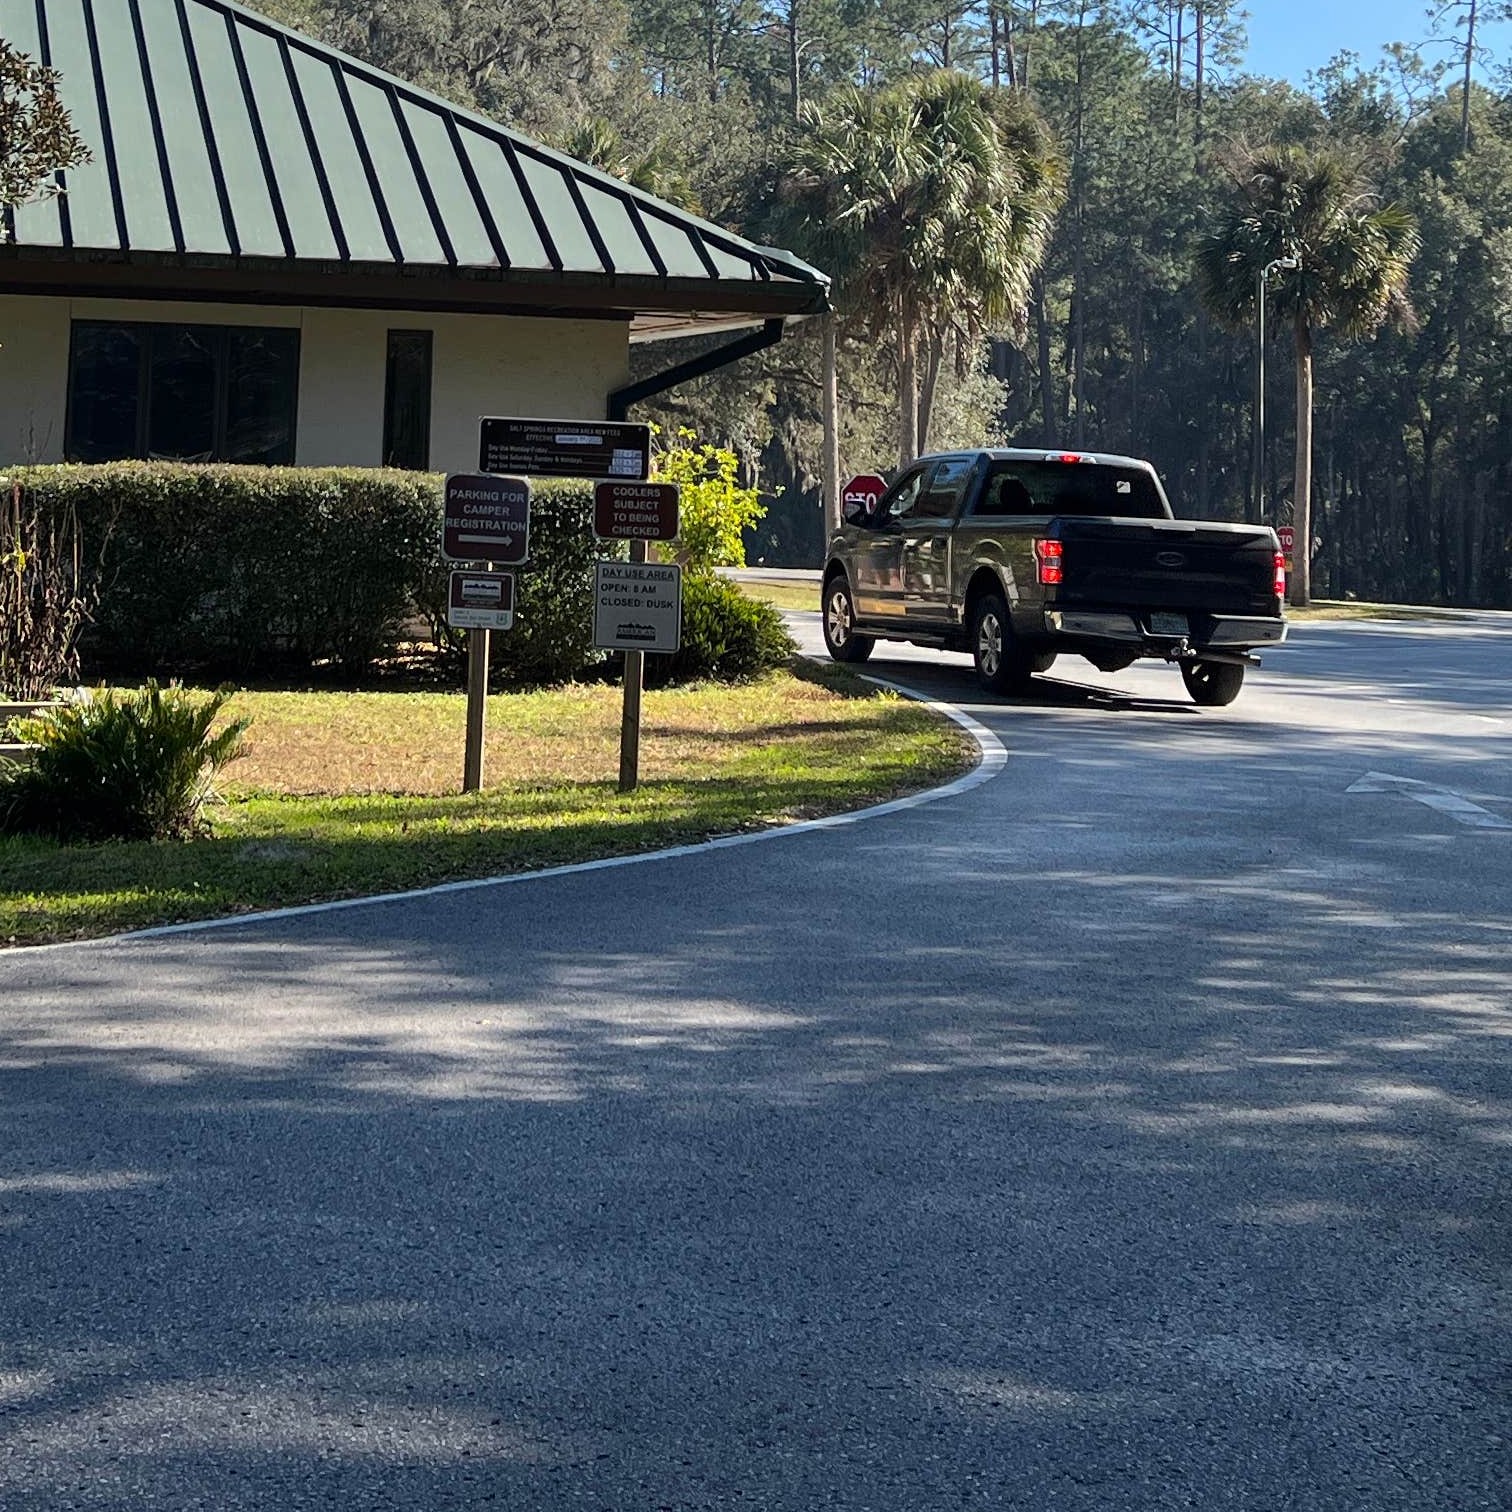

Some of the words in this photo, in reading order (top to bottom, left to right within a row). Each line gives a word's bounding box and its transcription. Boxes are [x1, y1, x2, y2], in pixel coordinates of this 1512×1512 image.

[450, 489, 499, 501] PARKING
[502, 492, 524, 503] FOR
[613, 488, 661, 497] COOLERS
[463, 504, 510, 516] CAMPER
[614, 499, 659, 510] SUBJECT
[614, 512, 627, 522] TO
[629, 513, 660, 523] BEING
[445, 517, 527, 532] REGISTRATION
[612, 525, 660, 536] CHECKED
[602, 568, 622, 578] DAY
[625, 569, 645, 580] USE
[648, 570, 675, 582] AREA
[641, 585, 657, 594] AM
[601, 597, 644, 608] CLOSED:
[647, 599, 674, 609] DUSK
